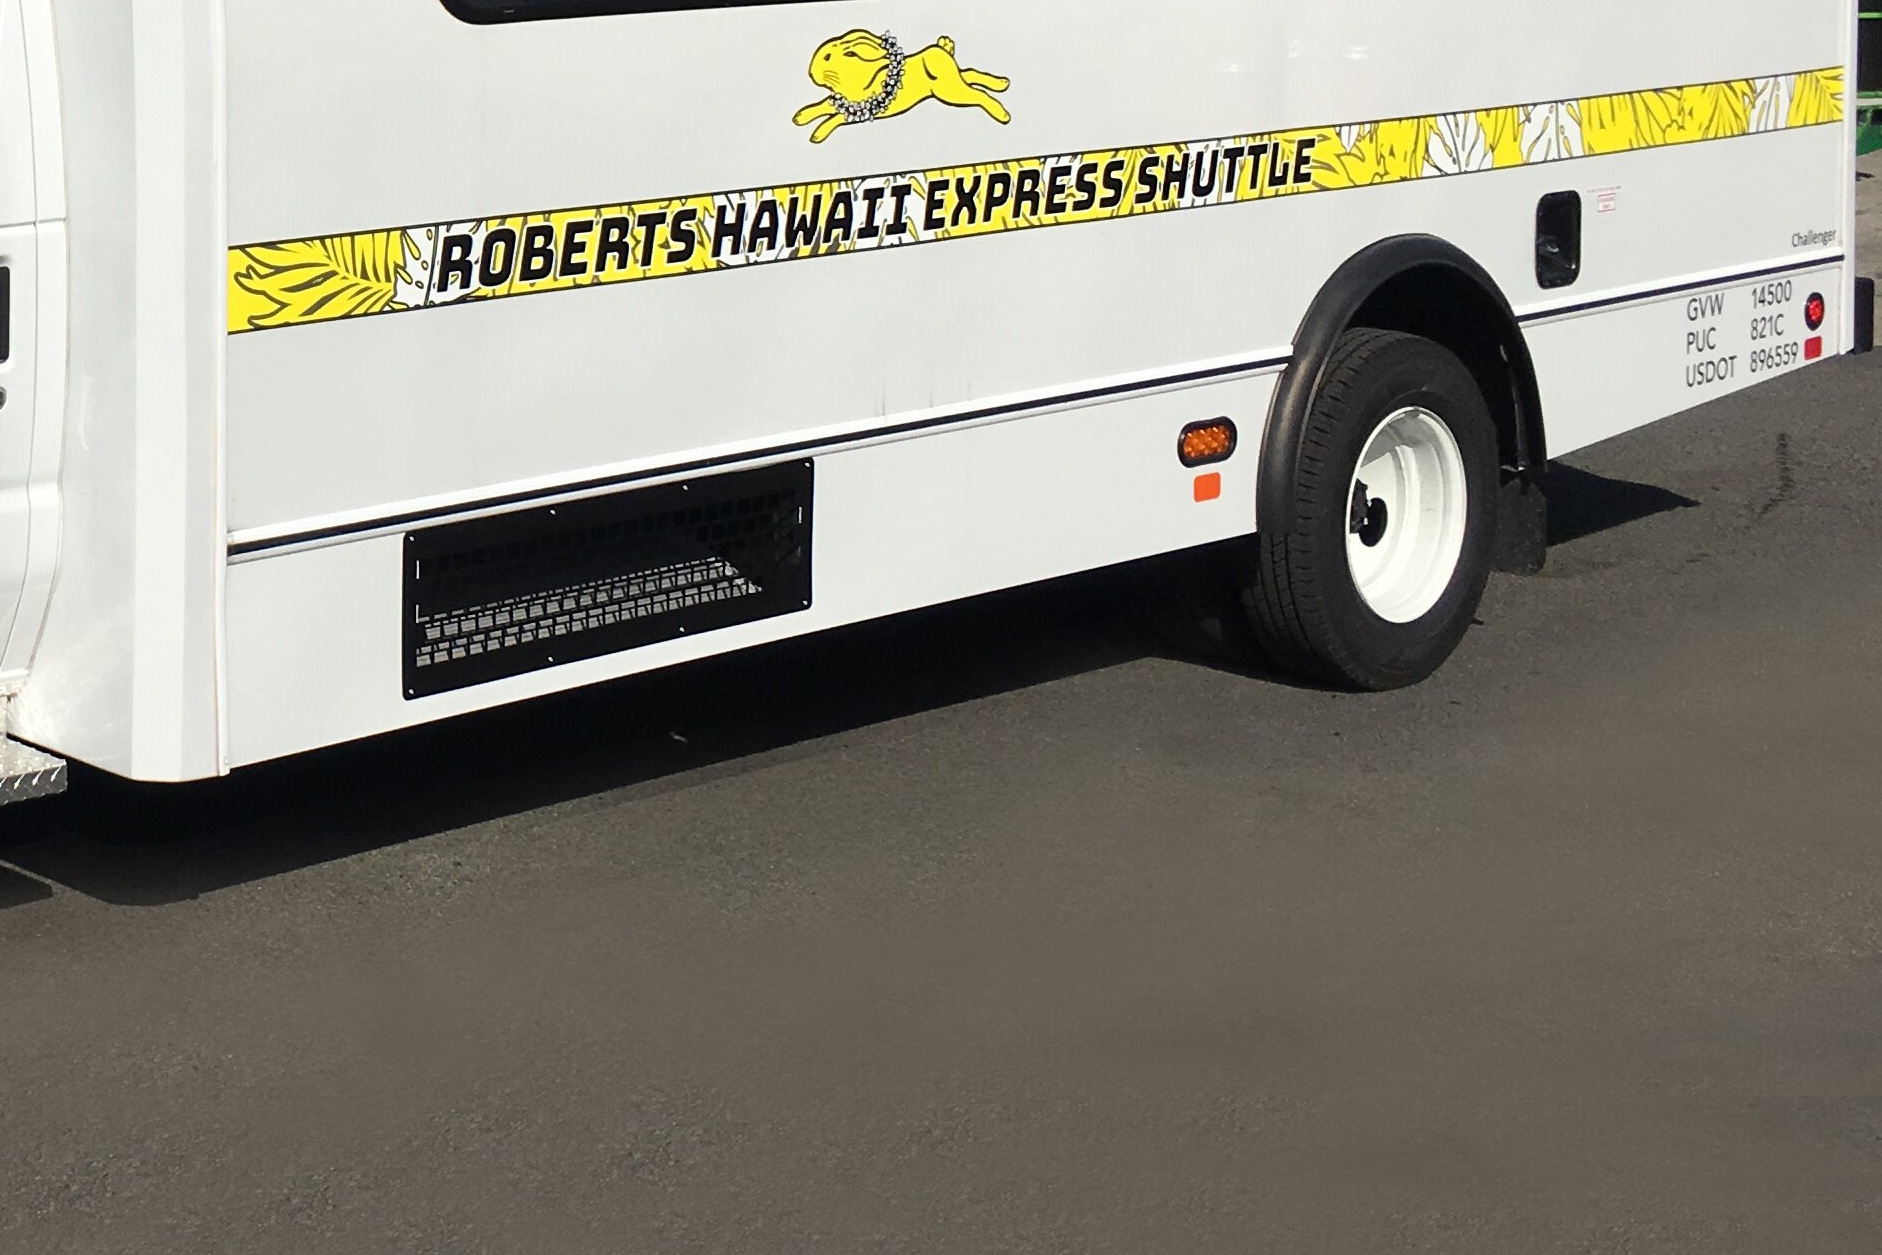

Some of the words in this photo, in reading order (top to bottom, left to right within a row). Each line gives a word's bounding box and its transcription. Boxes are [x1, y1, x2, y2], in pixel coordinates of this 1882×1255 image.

[437, 208, 699, 292] ROBERTS
[711, 177, 913, 258] HAWAII
[921, 161, 1127, 232] EXPRESS
[1134, 138, 1316, 204] SHUTTLE
[1791, 229, 1837, 248] Challenger
[1687, 293, 1725, 321] GVW
[1752, 280, 1792, 309] 14500
[1686, 327, 1716, 355] PUC
[1750, 313, 1784, 340] 821C
[1686, 355, 1738, 388] USDOT
[1750, 342, 1799, 373] 896559
